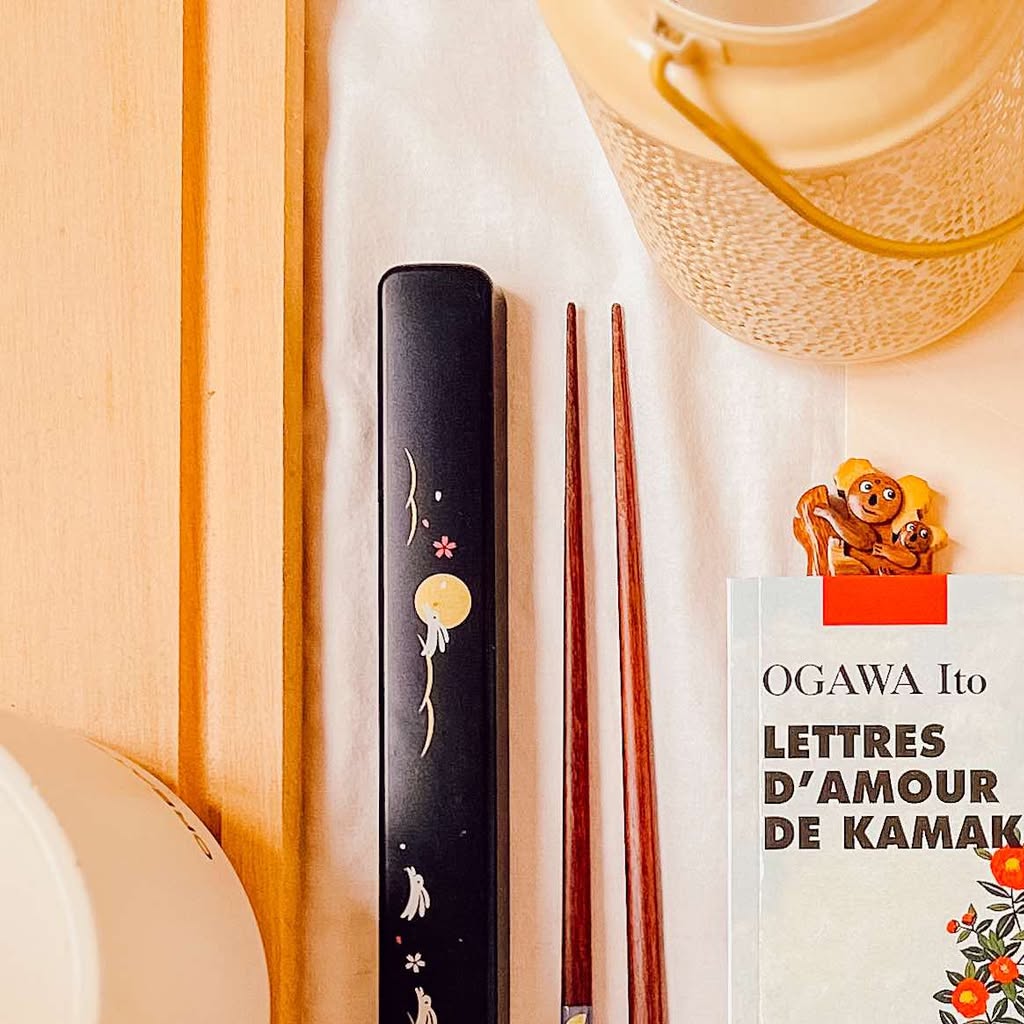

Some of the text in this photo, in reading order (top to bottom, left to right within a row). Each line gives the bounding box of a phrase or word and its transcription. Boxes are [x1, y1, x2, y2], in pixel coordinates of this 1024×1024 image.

[762, 663, 987, 697] OGAWA Ito
[763, 723, 946, 759] LETTRES
[763, 769, 1000, 804] D'AMOUR
[763, 816, 821, 850] DE
